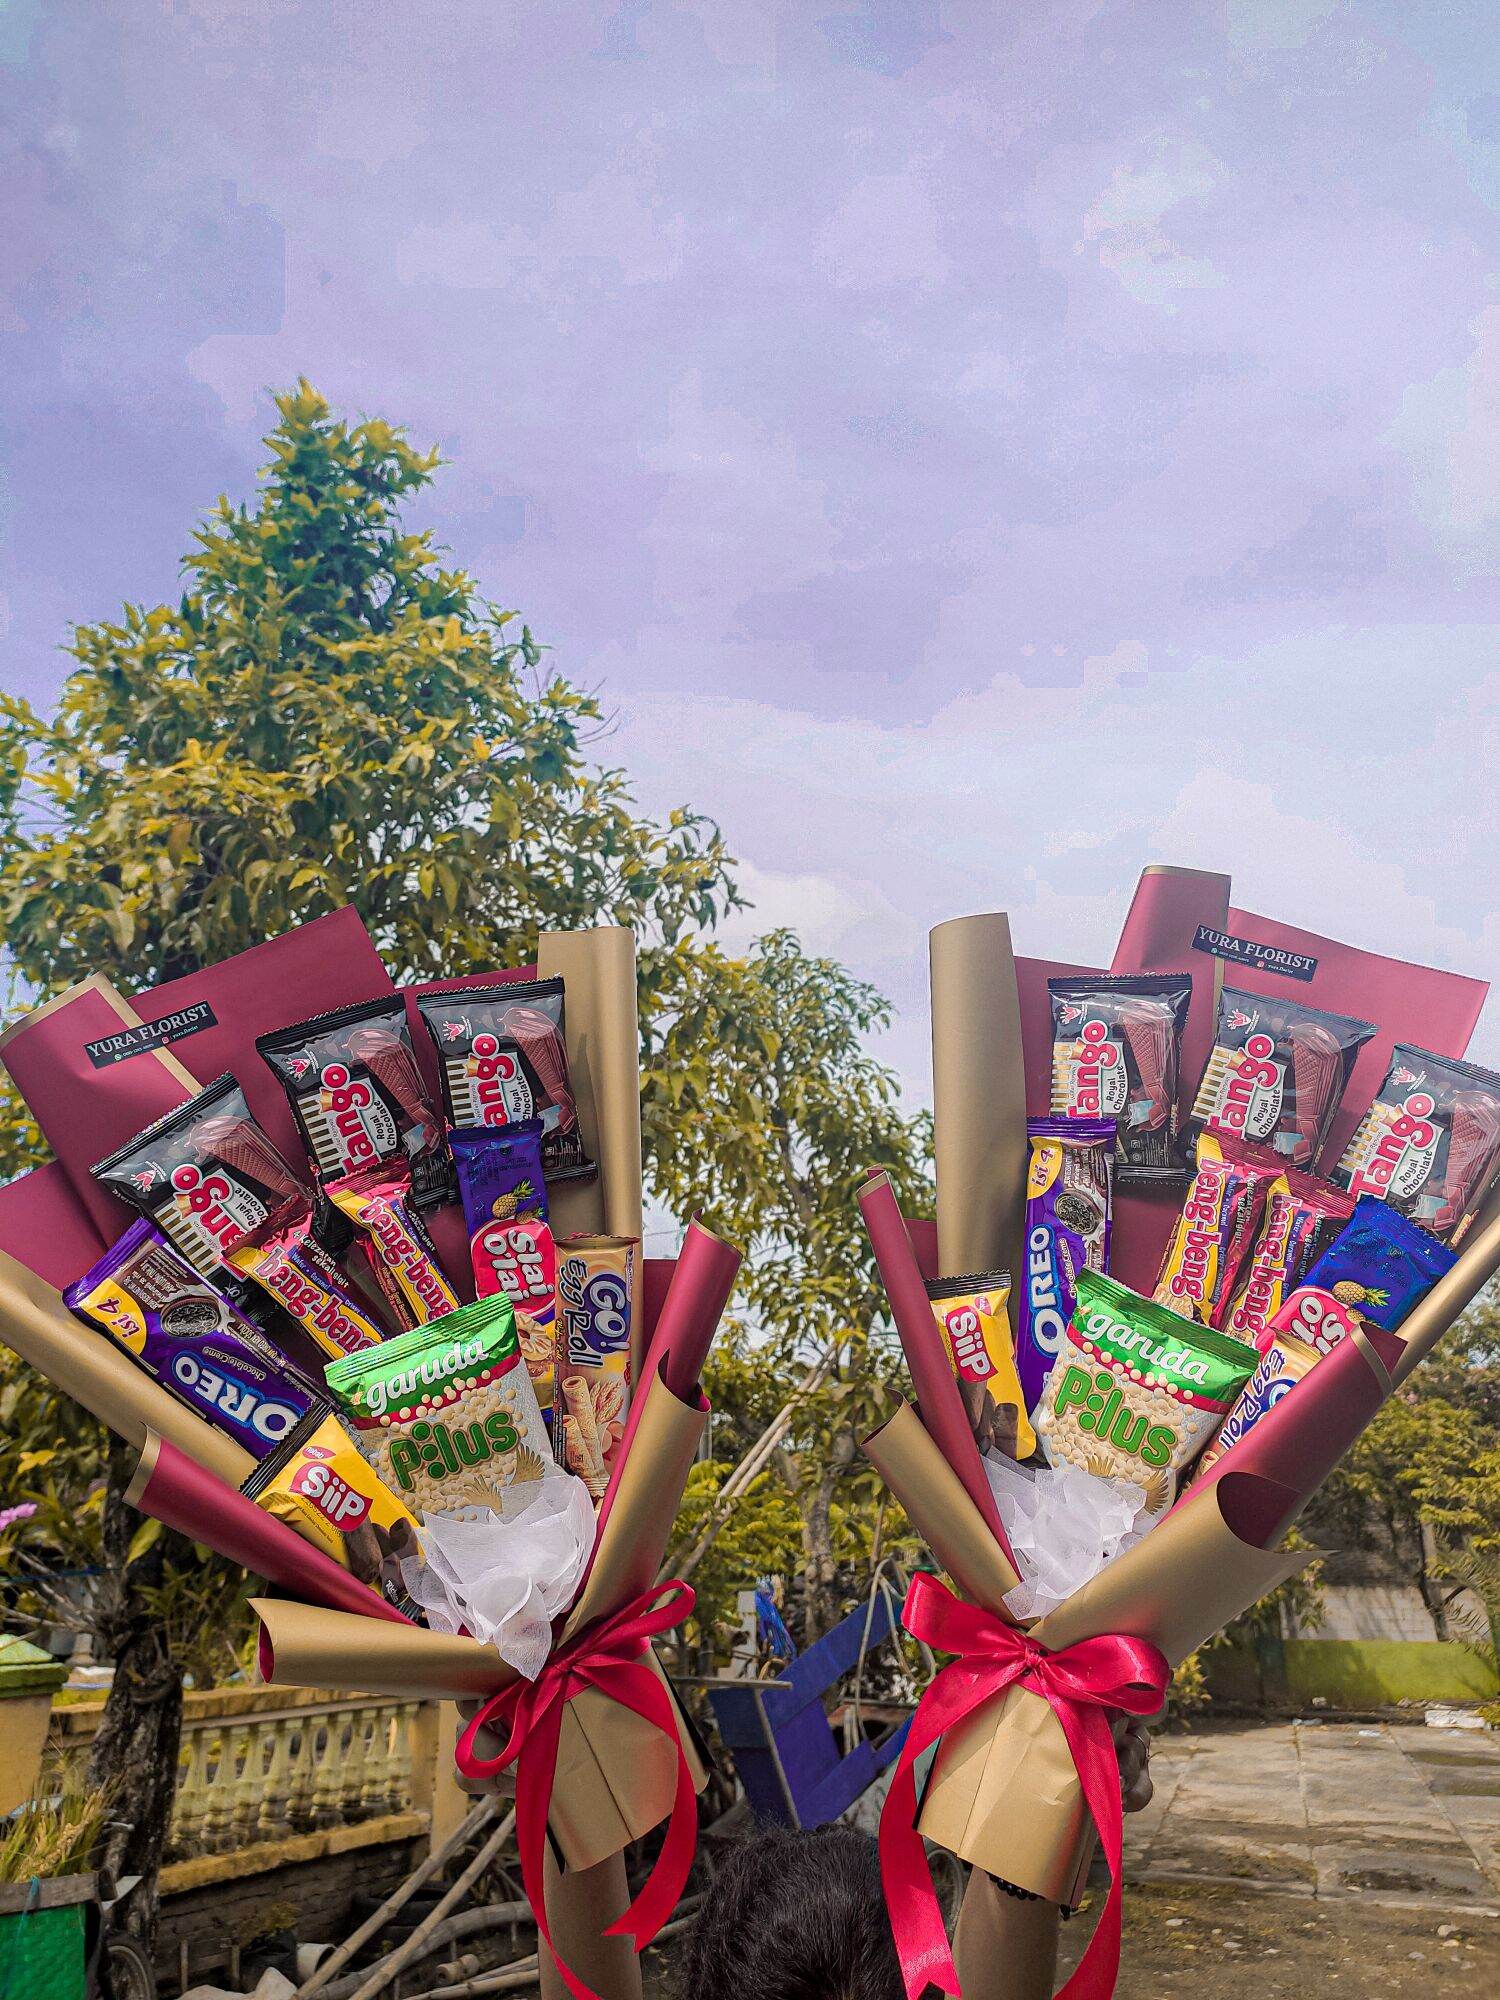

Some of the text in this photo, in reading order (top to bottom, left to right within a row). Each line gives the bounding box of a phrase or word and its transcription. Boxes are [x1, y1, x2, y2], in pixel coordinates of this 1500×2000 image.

[1199, 927, 1240, 952] YURA
[1243, 943, 1315, 971] FLORIST
[87, 1032, 139, 1057] YURA
[138, 1003, 209, 1041] FLORIST
[474, 1034, 515, 1126] ango
[510, 1089, 522, 1113] Royal
[1106, 1077, 1116, 1102] Royal
[1113, 1064, 1127, 1112] Chocolate
[369, 1115, 385, 1141] Royal
[373, 1099, 396, 1147] Chocolate
[1253, 1099, 1269, 1124] Royal
[1258, 1089, 1280, 1135] Chocolate
[1032, 1147, 1055, 1188] isi 4
[1349, 1094, 1434, 1198] Tango
[1399, 1158, 1419, 1184] Royal
[1403, 1150, 1433, 1196] Chocolate
[234, 1202, 258, 1227] Royal
[1170, 1157, 1235, 1301] beng-beng
[1292, 1215, 1305, 1234] Wafer
[300, 1234, 337, 1267] Kelezatan
[358, 1196, 455, 1321] beng-beng
[1233, 1194, 1303, 1337] beng-beng
[560, 1258, 604, 1366] Egg Roll
[1030, 1227, 1066, 1353] OREO
[96, 1297, 141, 1338] isi 4
[590, 1280, 630, 1351] GO!
[203, 1345, 229, 1364] Creme
[229, 1355, 267, 1382] Chocolate
[1082, 1313, 1210, 1385] garuda
[1251, 1348, 1286, 1398] Egg
[175, 1356, 300, 1441] OREO
[366, 1338, 489, 1418] garuda
[1218, 1391, 1261, 1450] Roll
